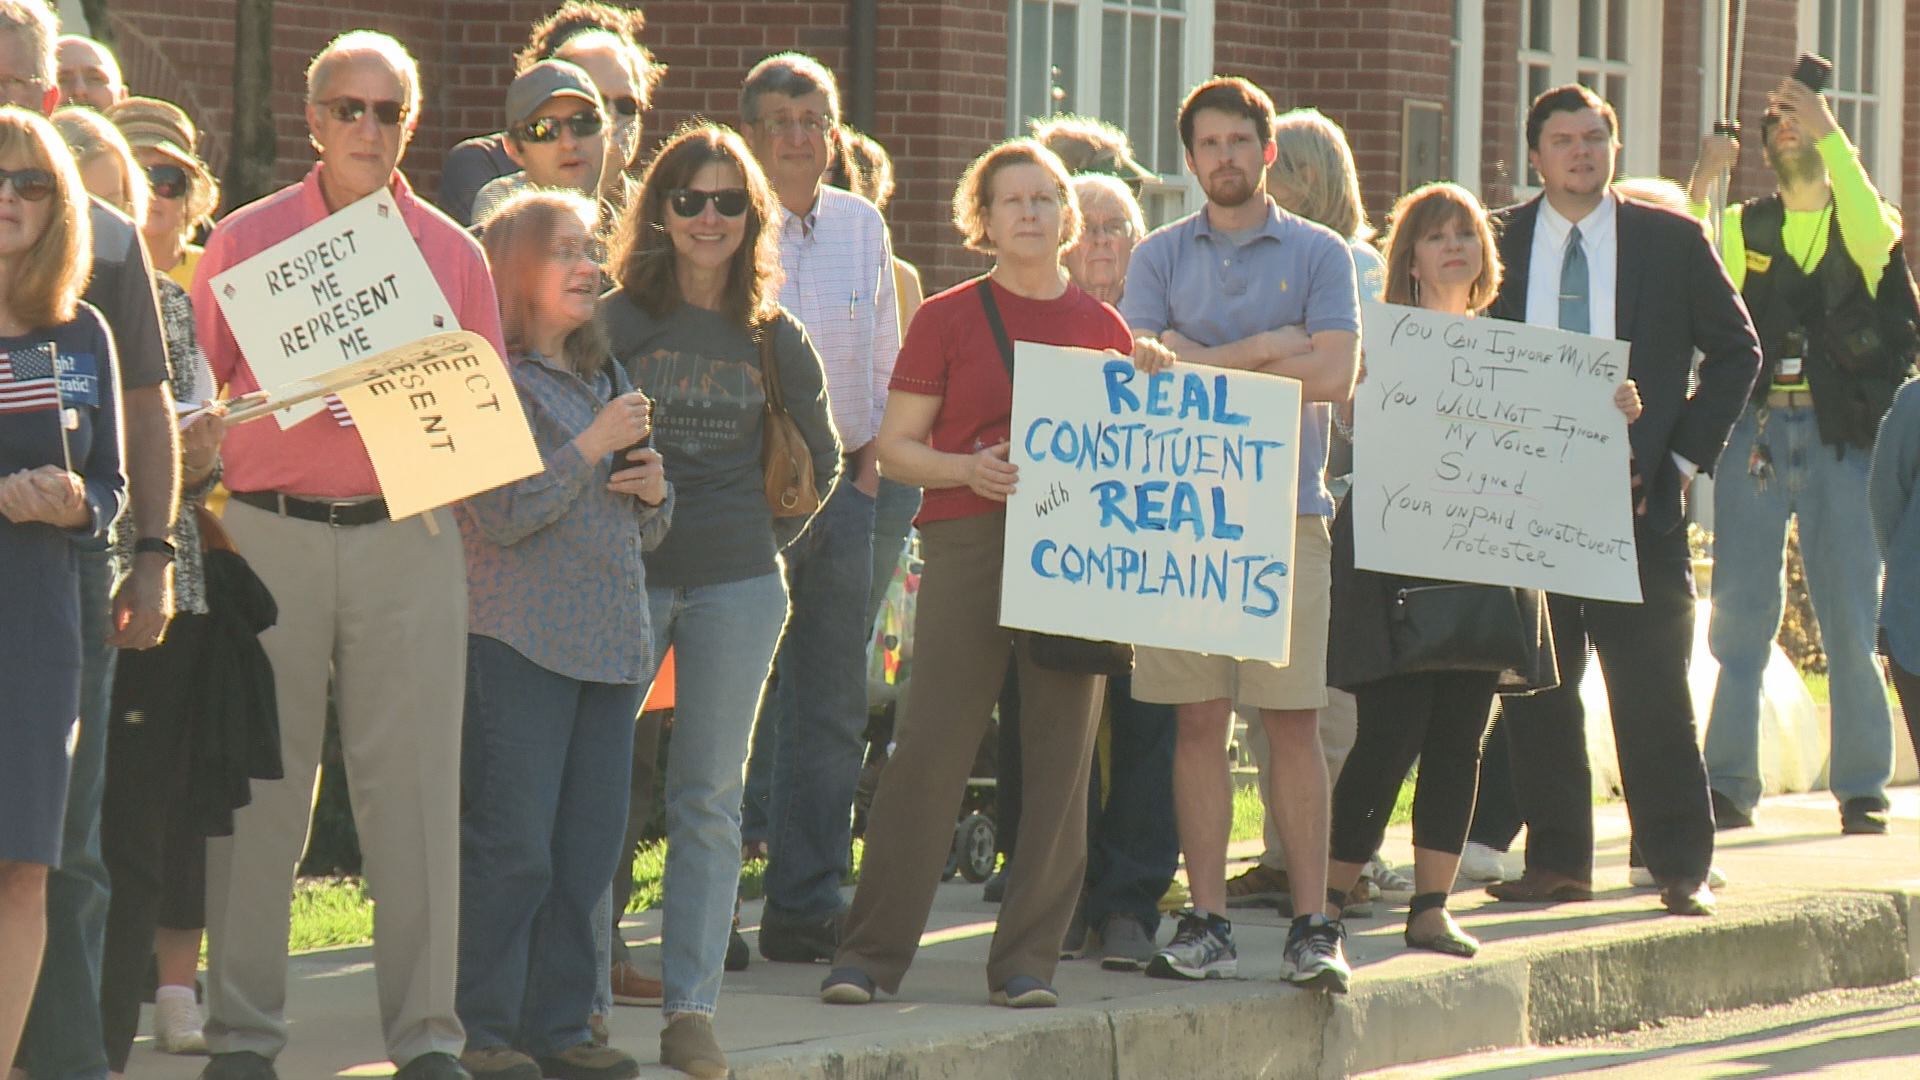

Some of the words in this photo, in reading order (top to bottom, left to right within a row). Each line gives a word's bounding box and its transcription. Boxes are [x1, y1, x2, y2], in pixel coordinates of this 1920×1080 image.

[265, 229, 359, 296] RESPECT
[310, 272, 343, 306] ME
[279, 273, 401, 358] REPRESENT
[338, 327, 372, 360] ME
[1103, 359, 1252, 425] REAL
[1024, 417, 1286, 483] CONSTITUENT
[1034, 481, 1070, 519] with
[1090, 479, 1244, 543] REAL
[1030, 538, 1289, 618] COMPLAINTS
